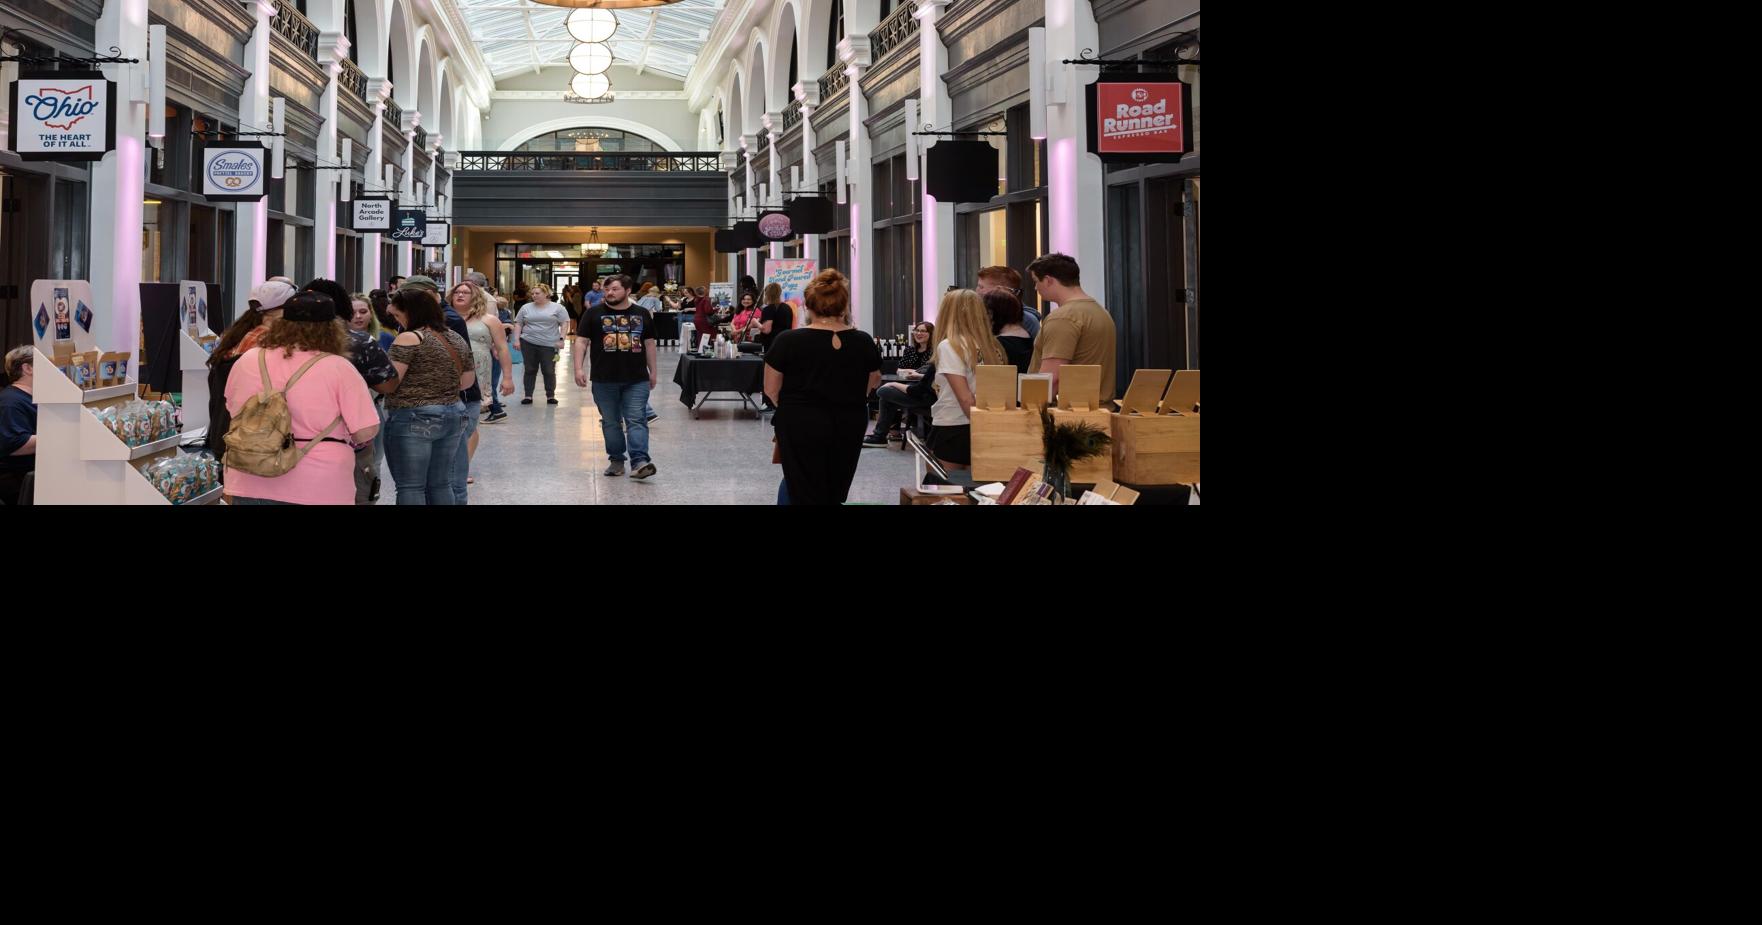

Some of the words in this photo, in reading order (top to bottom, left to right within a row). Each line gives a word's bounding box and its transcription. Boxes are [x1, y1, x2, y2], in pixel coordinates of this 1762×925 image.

[25, 95, 98, 120] Ohio
[1116, 98, 1167, 119] Road
[1103, 113, 1173, 132] Runner
[213, 159, 253, 171] Smales
[392, 226, 424, 238] Luke's
